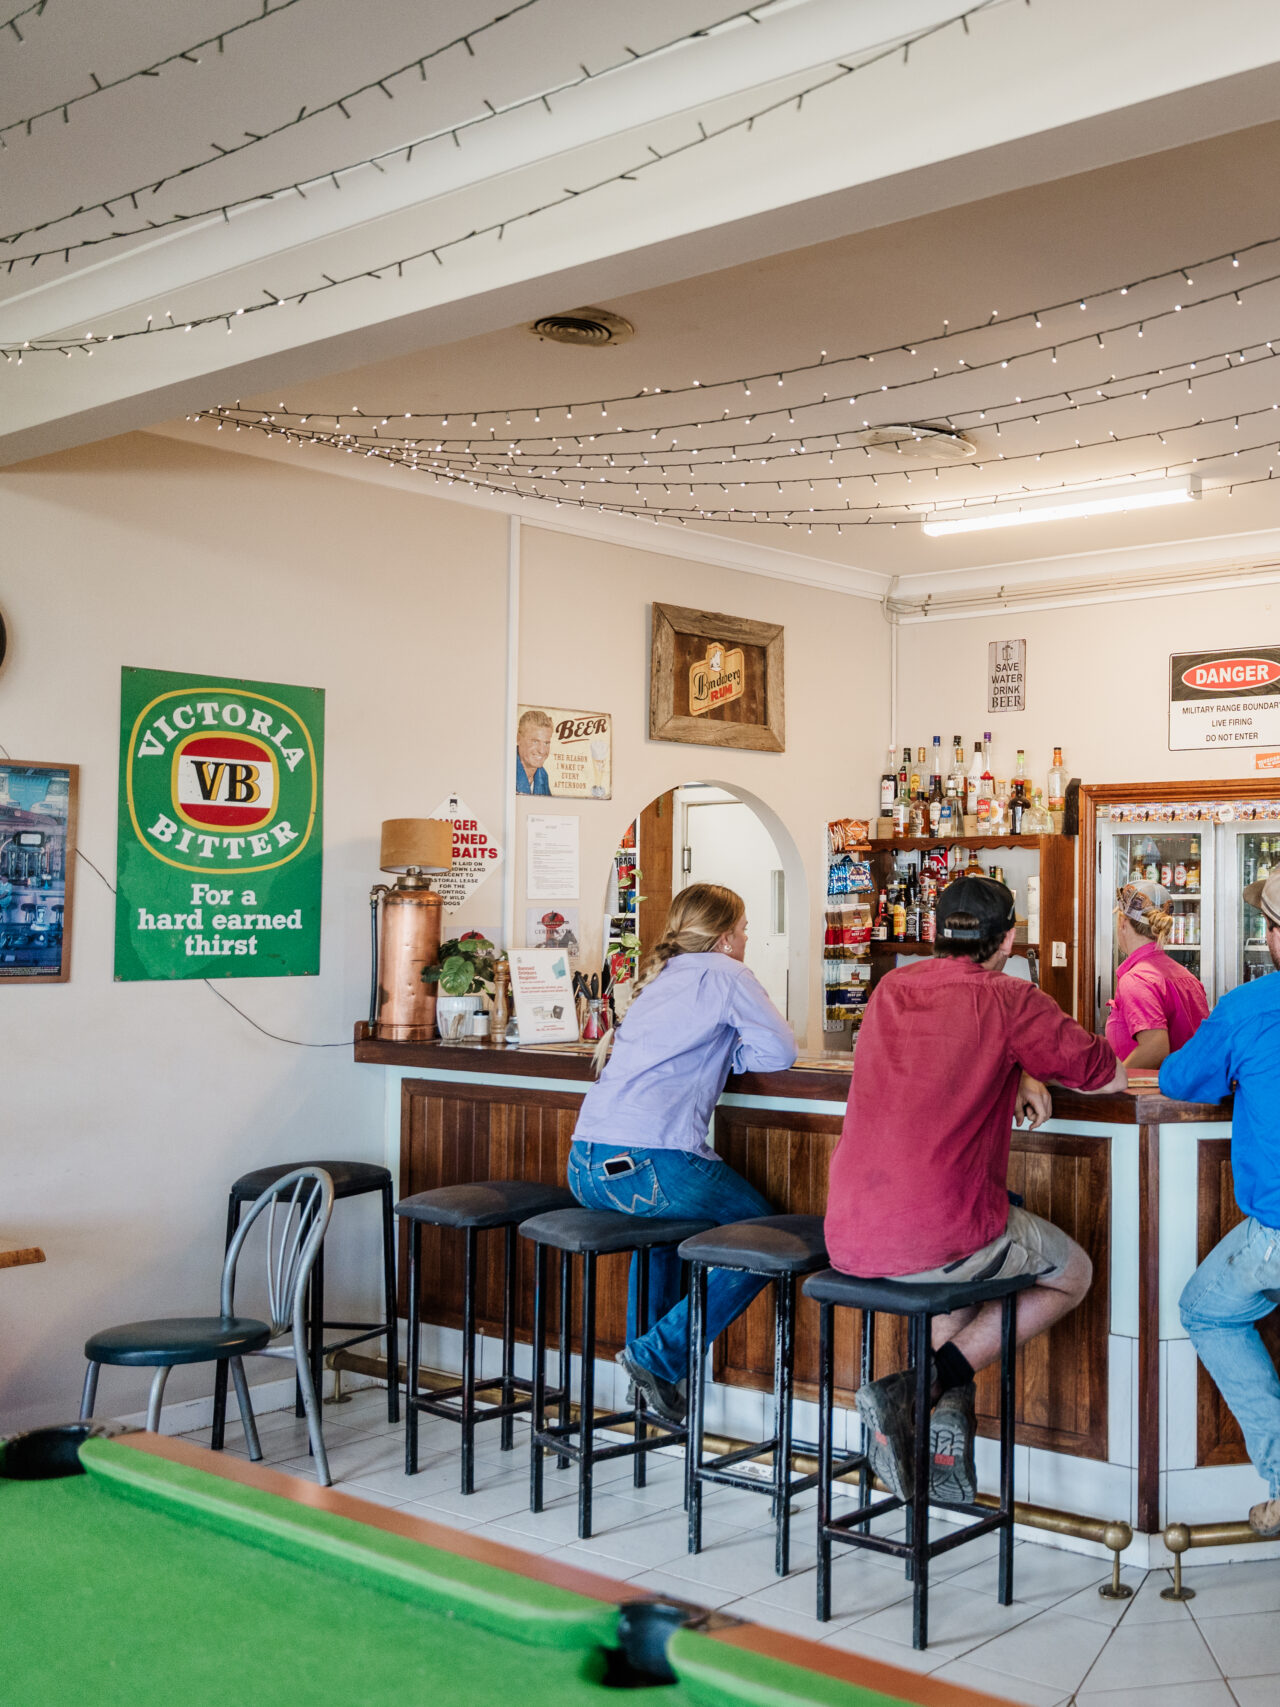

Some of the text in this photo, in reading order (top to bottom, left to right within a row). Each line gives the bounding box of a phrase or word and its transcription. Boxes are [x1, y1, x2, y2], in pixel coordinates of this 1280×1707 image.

[996, 663, 1019, 672] SAVE
[1196, 665, 1269, 684] DANGER
[992, 674, 1022, 684] WATER
[711, 684, 732, 702] RUM
[993, 685, 1020, 695] DRINK
[992, 696, 1021, 708] BEER
[1182, 706, 1214, 714] MILITARY
[1217, 704, 1240, 712] RANGE
[138, 702, 305, 772] VICTORIA
[556, 719, 607, 740] BEER
[191, 760, 262, 804] VB
[147, 814, 299, 860] BITTER
[190, 884, 257, 905] For a
[138, 908, 302, 930] hard earned
[185, 934, 258, 956] thirst
